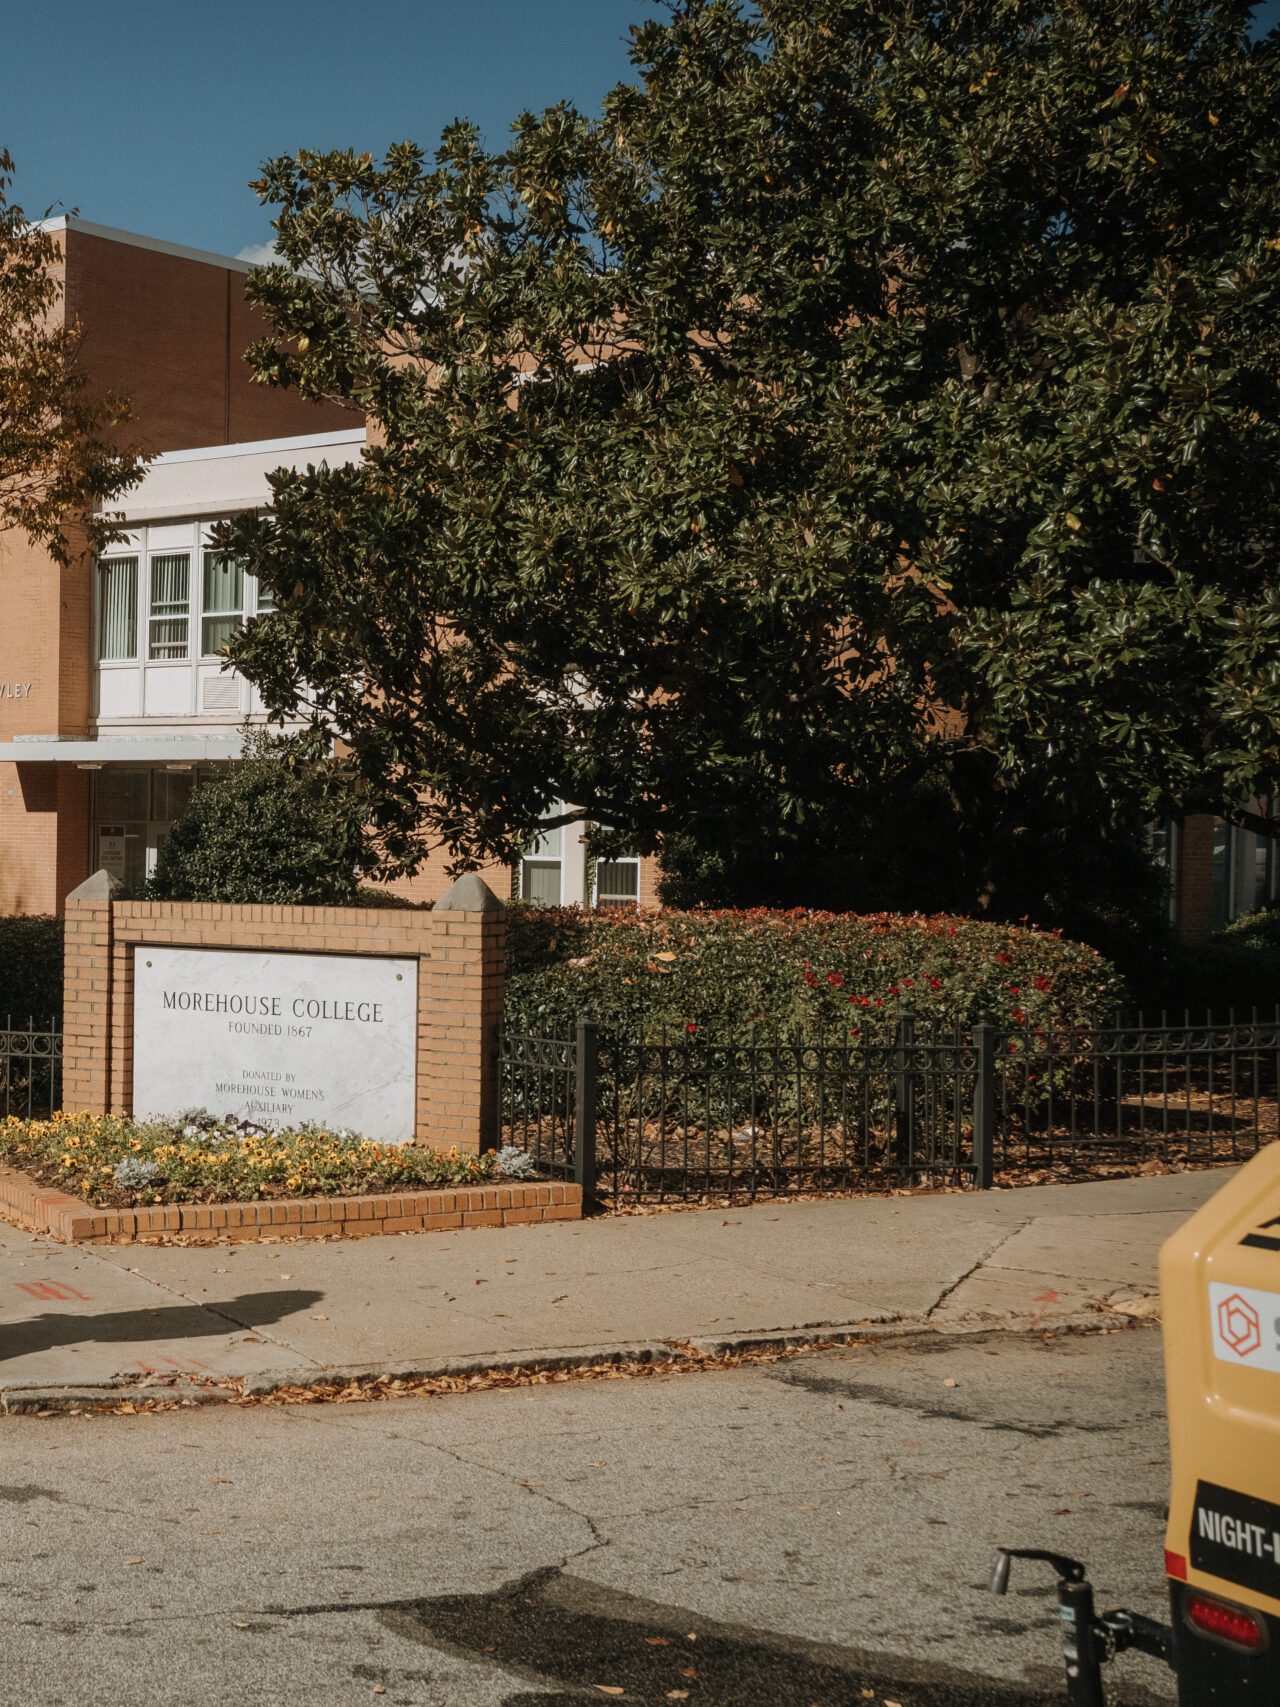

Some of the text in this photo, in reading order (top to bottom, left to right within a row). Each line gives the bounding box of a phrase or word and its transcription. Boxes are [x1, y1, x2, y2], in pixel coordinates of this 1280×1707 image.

[163, 991, 384, 1023] MOREHOUSE COLLEGE
[228, 1022, 313, 1038] FOUNDED 1867
[242, 1070, 296, 1083] DONATED BY
[215, 1083, 325, 1101] MOREHOUSE WOMEN'S
[244, 1101, 294, 1115] AUXILIARY
[257, 1118, 280, 1129] 1973
